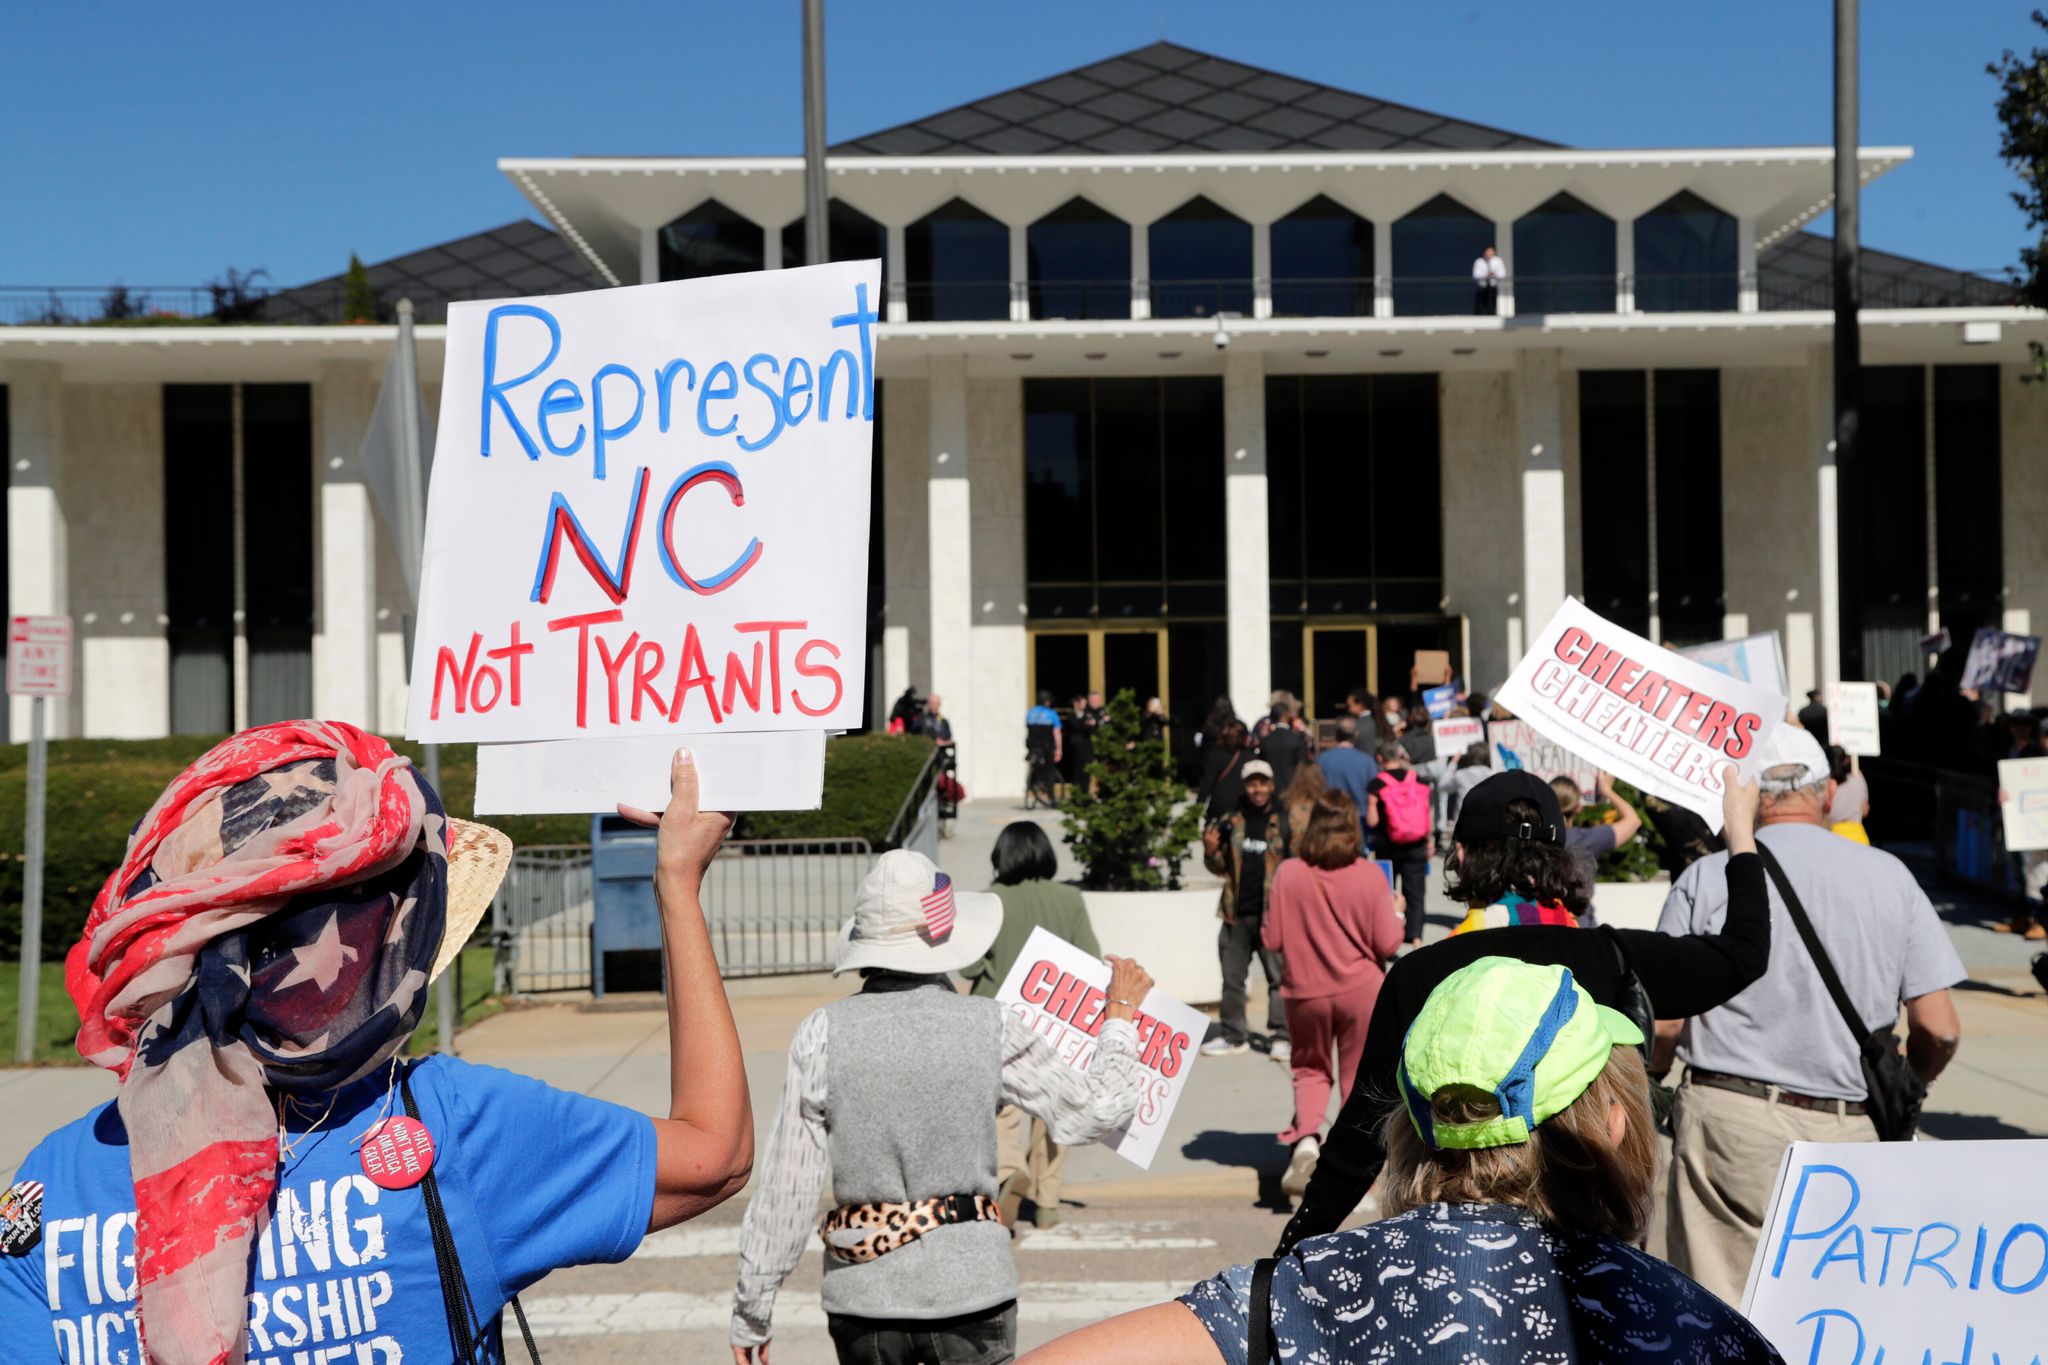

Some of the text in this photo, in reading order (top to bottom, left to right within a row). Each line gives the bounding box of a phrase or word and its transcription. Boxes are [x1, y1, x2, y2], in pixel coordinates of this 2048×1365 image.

[480, 282, 879, 481] Represent
[529, 460, 763, 605] NC
[548, 609, 844, 728] TYRANTS
[1530, 658, 1740, 797] CHEATERS
[1554, 627, 1762, 759] CHEATERS
[1020, 959, 1190, 1078] CHEERS
[362, 1146, 385, 1176] GREAT
[376, 1133, 402, 1175] AMERICA
[400, 1147, 421, 1176] MAKE
[412, 1128, 433, 1157] HATE
